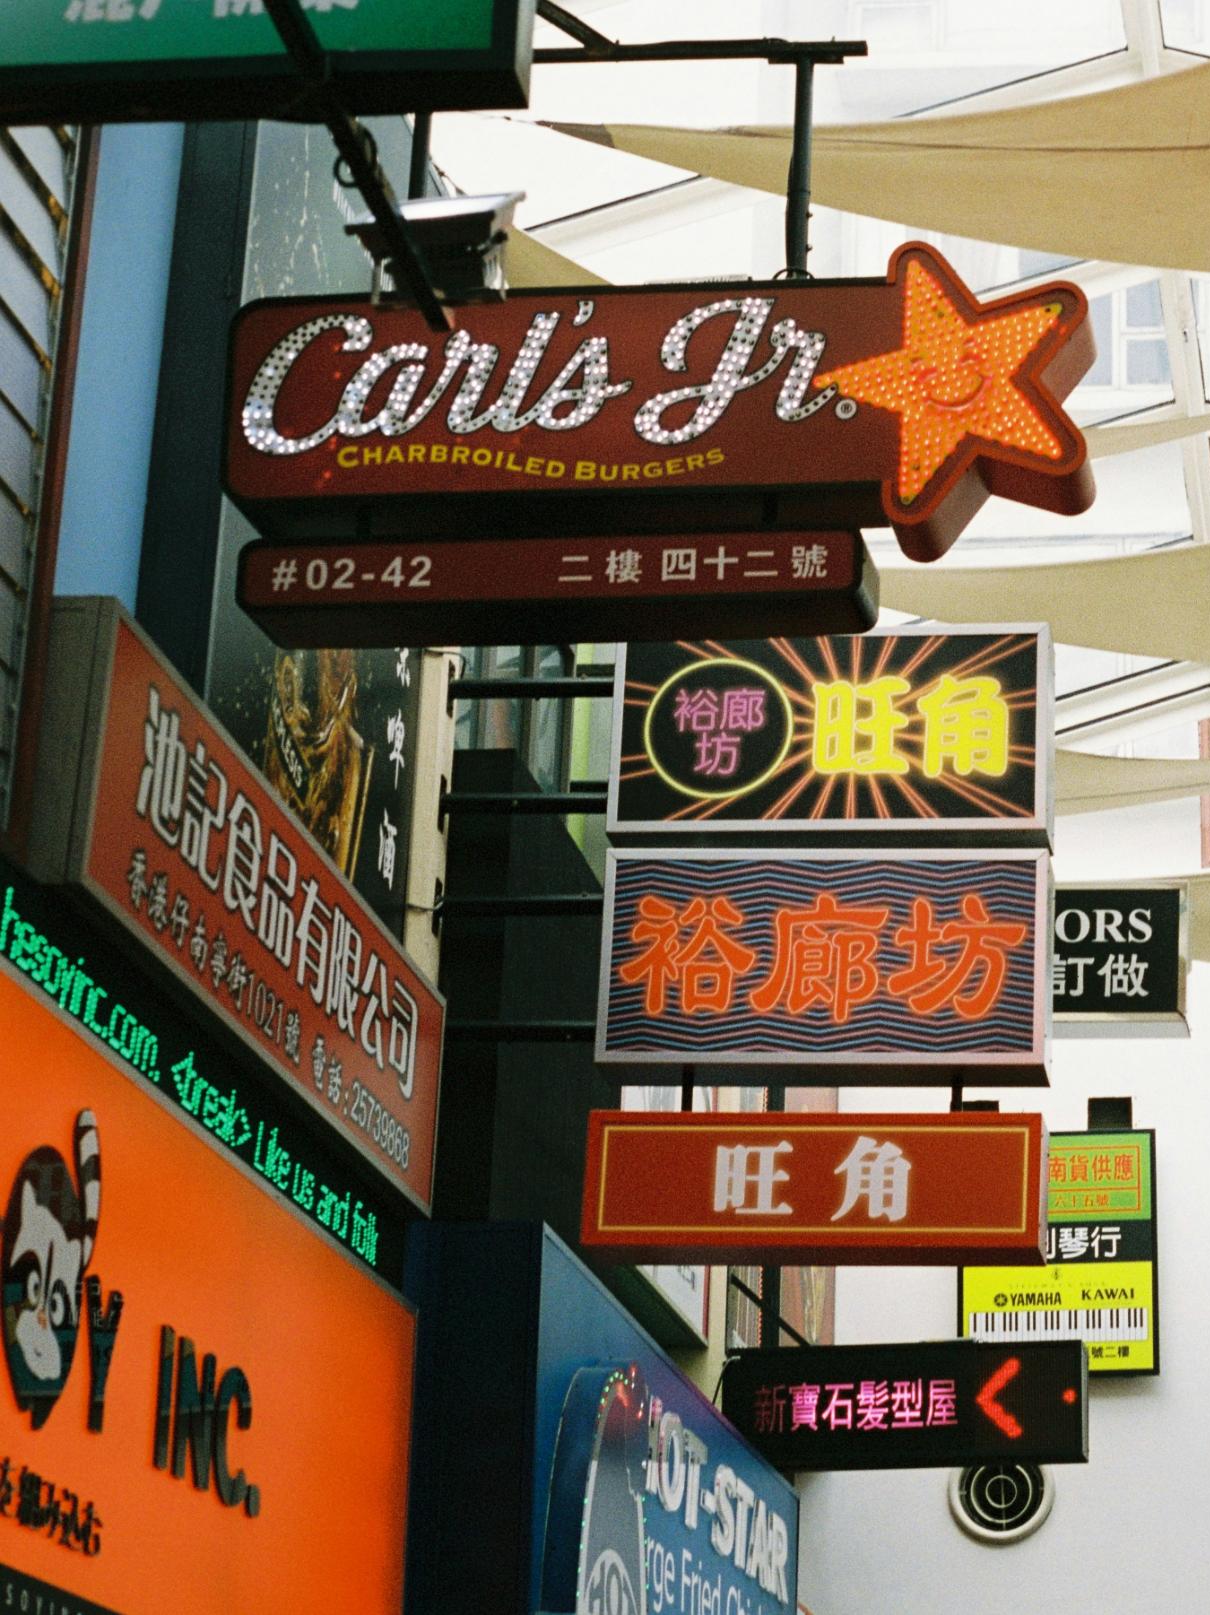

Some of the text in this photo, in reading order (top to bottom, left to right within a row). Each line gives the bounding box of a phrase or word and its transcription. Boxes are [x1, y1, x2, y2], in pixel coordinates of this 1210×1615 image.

[243, 300, 632, 455] Carl's
[337, 444, 725, 482] CHARBROILED BURGERS
[272, 556, 433, 591] #02-42
[811, 675, 1010, 779] 旺角
[136, 684, 418, 1100] 池記食品有限公司
[1055, 908, 1153, 944] ORS
[619, 893, 1026, 1024] 裕廊坊
[1053, 953, 1149, 998] 訂做
[253, 1120, 291, 1191] Like
[293, 1162, 315, 1211] us
[316, 1183, 351, 1240] and
[712, 1135, 912, 1223] 旺角
[1010, 1288, 1135, 1307] YAMAHA KAWAI
[152, 1324, 261, 1519] INC.
